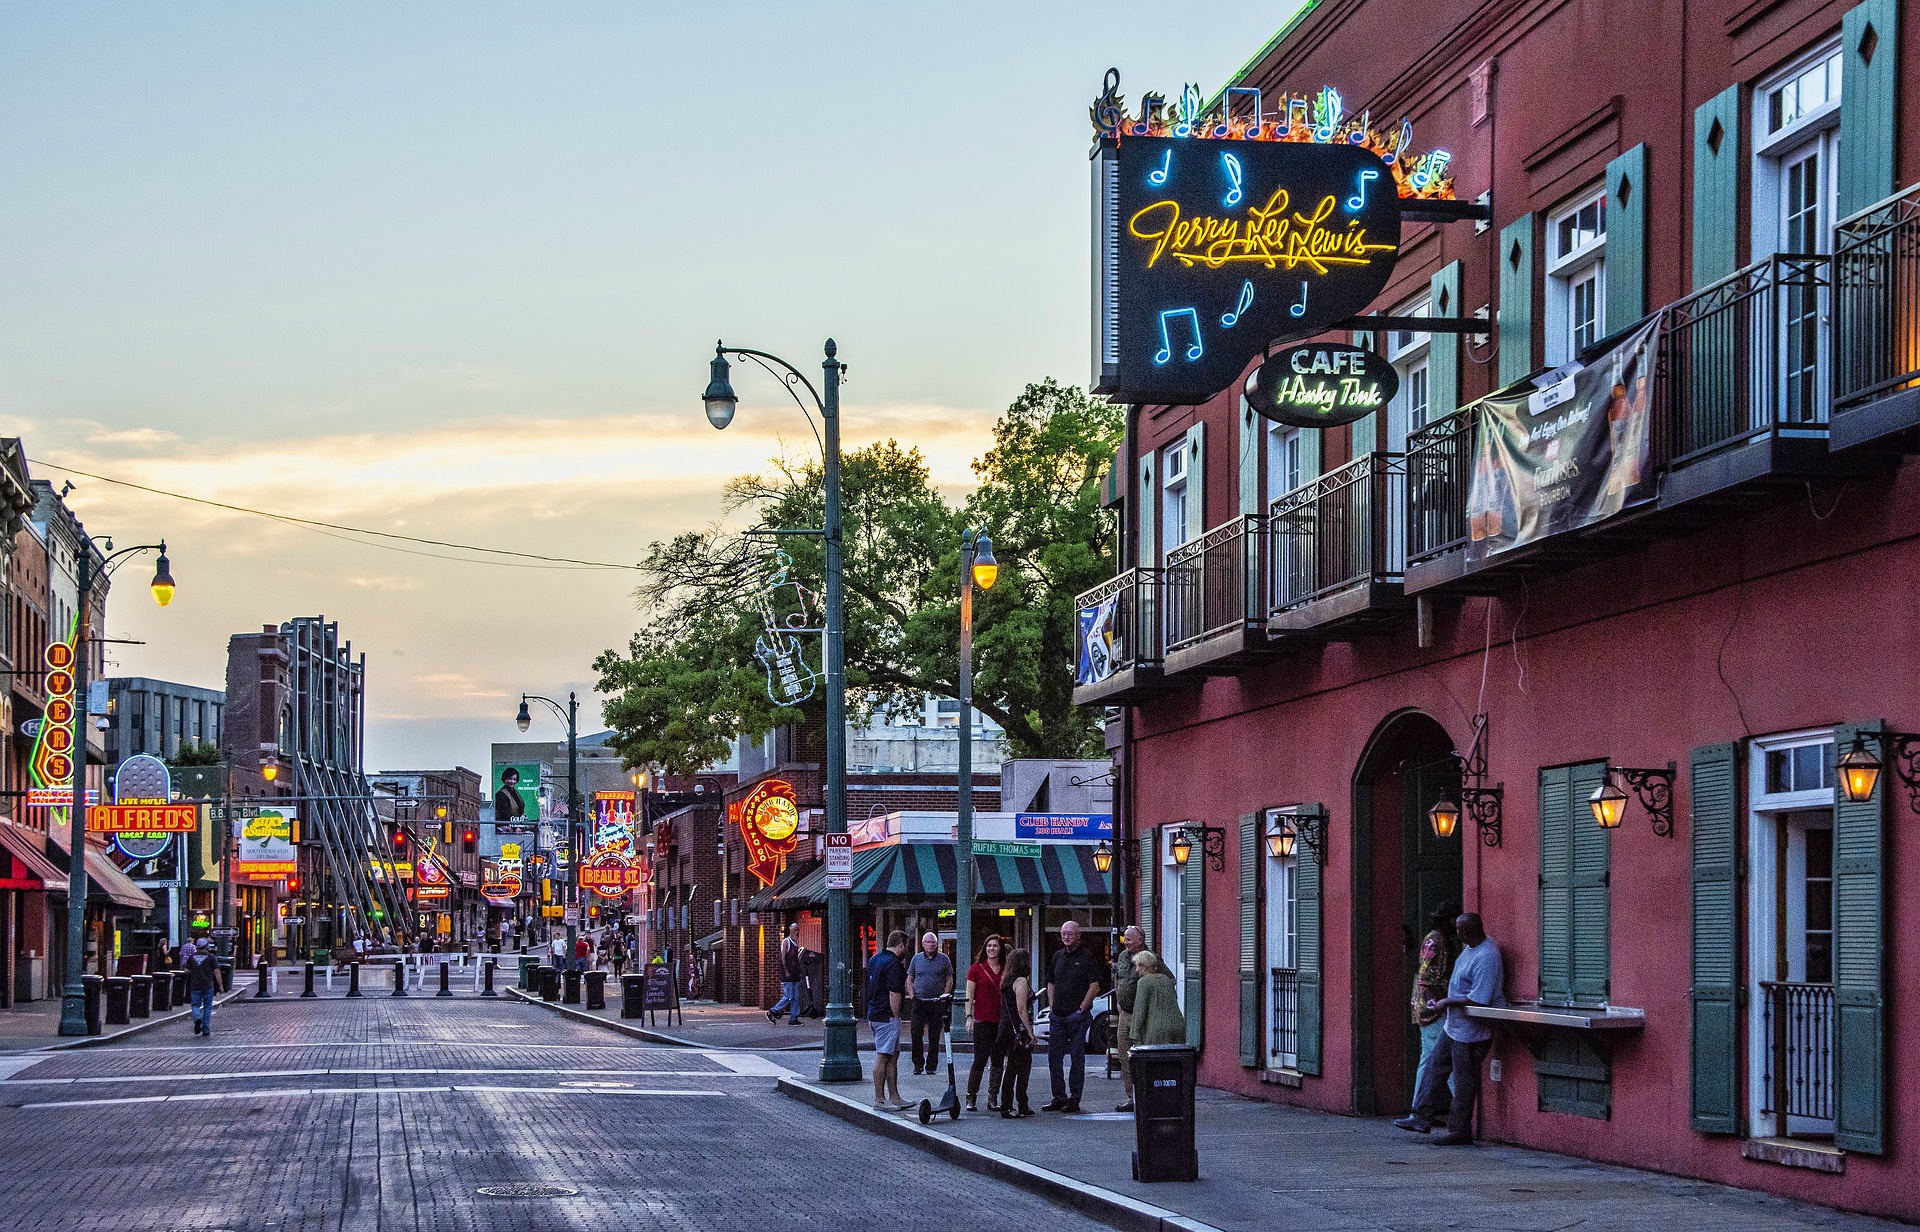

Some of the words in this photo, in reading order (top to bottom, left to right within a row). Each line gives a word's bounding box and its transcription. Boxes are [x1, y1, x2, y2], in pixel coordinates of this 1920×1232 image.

[1129, 200, 1240, 268] Jerry
[1247, 189, 1289, 269] Lee
[1289, 195, 1397, 274] Lewis
[1291, 349, 1366, 375] CAFE
[1277, 375, 1337, 411] Honky
[1339, 377, 1383, 406] Tonk
[1540, 485, 1572, 507] BOURBON
[52, 646, 66, 777] DYER'S
[210, 809, 226, 819] B.B.
[242, 807, 260, 818] Blvd.
[746, 790, 767, 829] DRINKS
[776, 798, 796, 818] HANDY
[93, 807, 194, 830] ALFRED'S
[1019, 817, 1049, 826] CLUB
[1050, 817, 1089, 827] HANDY
[750, 832, 760, 846] TO
[831, 836, 847, 845] NO
[973, 843, 997, 853] RUFUS
[1000, 844, 1029, 855] THOMAS
[757, 848, 766, 861] GO
[584, 869, 621, 883] BEALE
[624, 869, 639, 883] ST.
